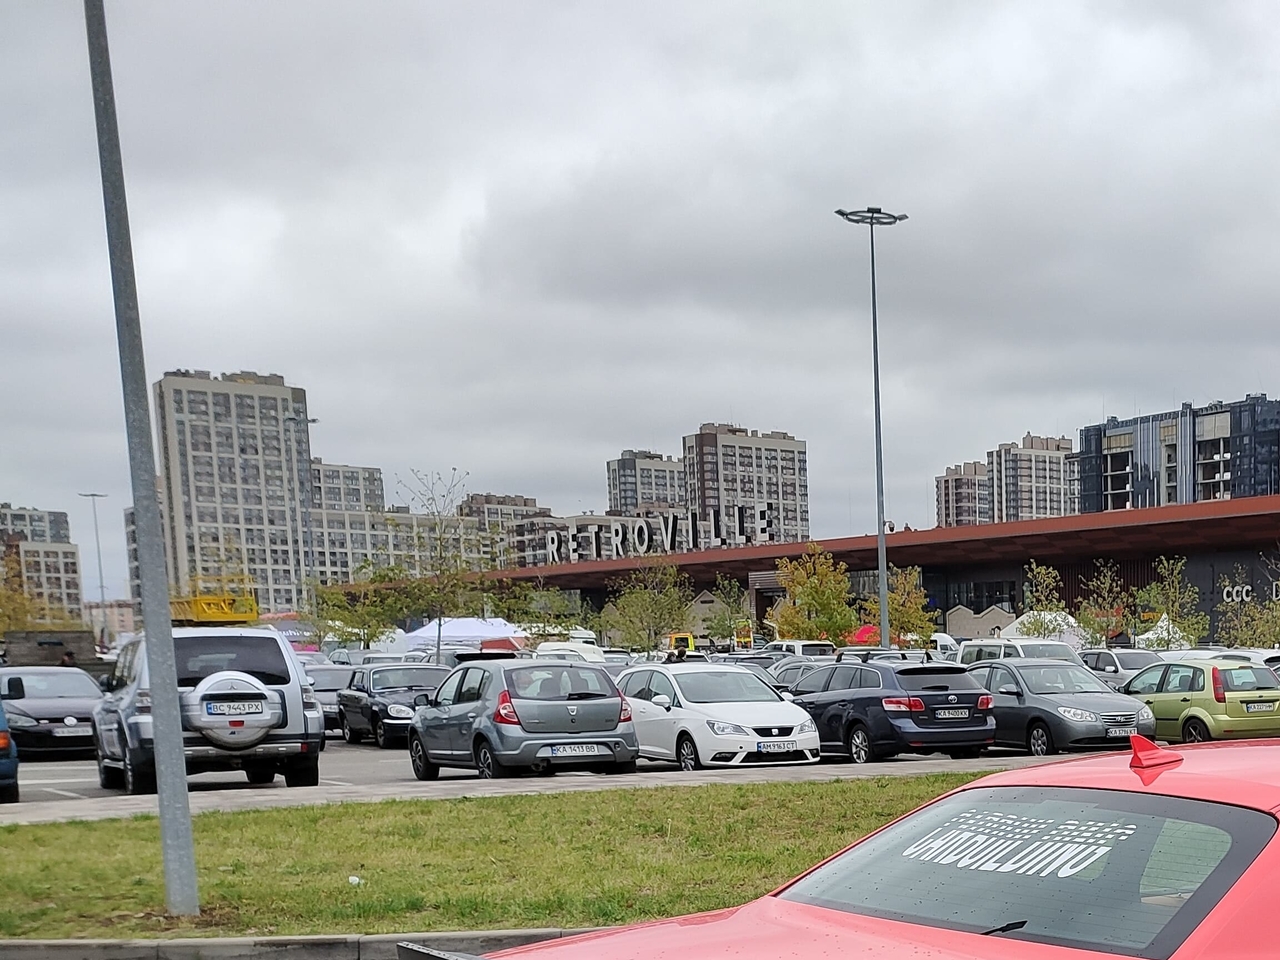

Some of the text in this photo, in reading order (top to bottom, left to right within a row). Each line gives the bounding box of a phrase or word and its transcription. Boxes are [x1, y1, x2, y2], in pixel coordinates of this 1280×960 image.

[546, 502, 775, 565] RETROVILLE
[1222, 585, 1252, 602] CCC
[212, 703, 260, 712] BC 9443 PX
